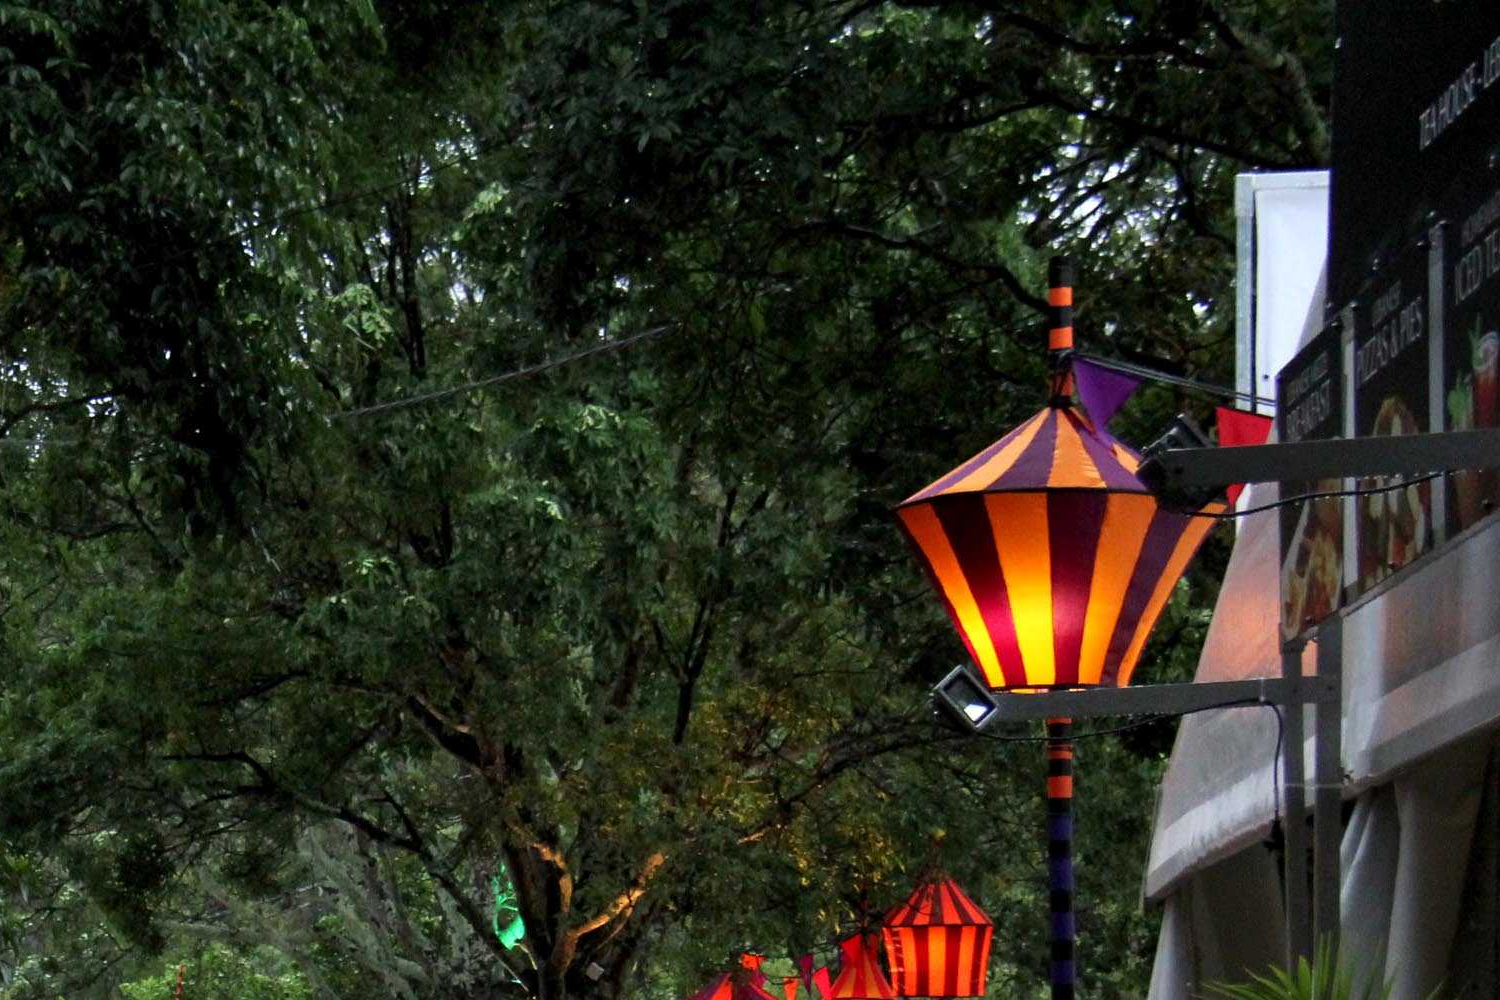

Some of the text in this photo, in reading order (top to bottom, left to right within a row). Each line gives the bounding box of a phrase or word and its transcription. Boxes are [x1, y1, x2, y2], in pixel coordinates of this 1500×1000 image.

[1419, 104, 1437, 151] TEA
[1438, 62, 1475, 135] HOUSE
[1484, 228, 1500, 280] TE
